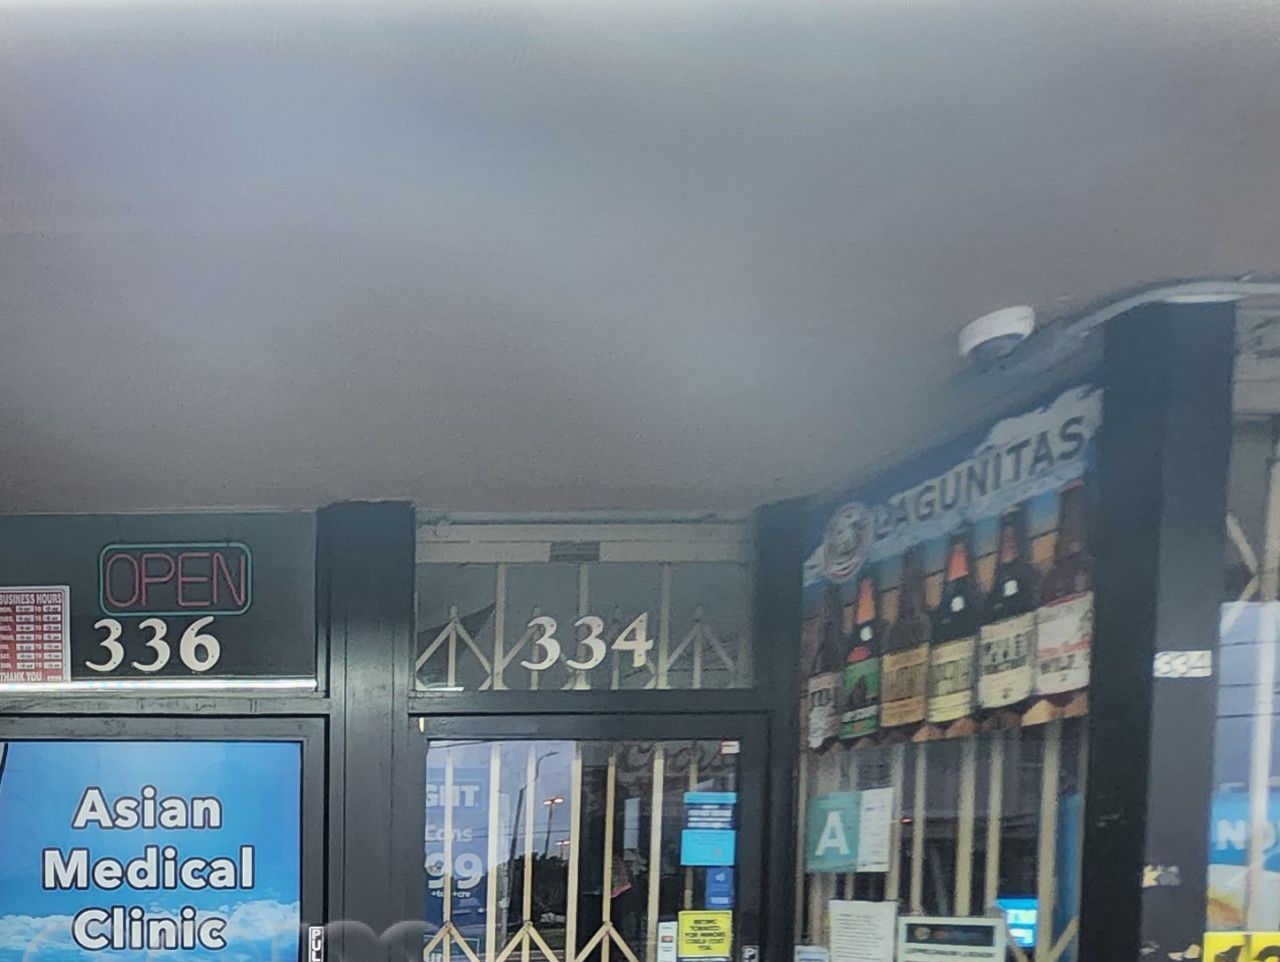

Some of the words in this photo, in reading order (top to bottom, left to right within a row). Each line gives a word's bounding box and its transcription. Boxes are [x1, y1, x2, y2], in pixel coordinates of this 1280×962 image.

[873, 415, 1086, 539] LAGUNITAS
[36, 593, 62, 604] HOURS
[105, 552, 246, 608] OPEN
[85, 616, 220, 672] 336
[521, 612, 654, 670] 334
[0, 671, 25, 681] THANK
[26, 671, 42, 681] YOU
[71, 785, 223, 831] Asian
[814, 811, 851, 856] A
[41, 844, 256, 890] Medical
[72, 905, 228, 951] Clinic
